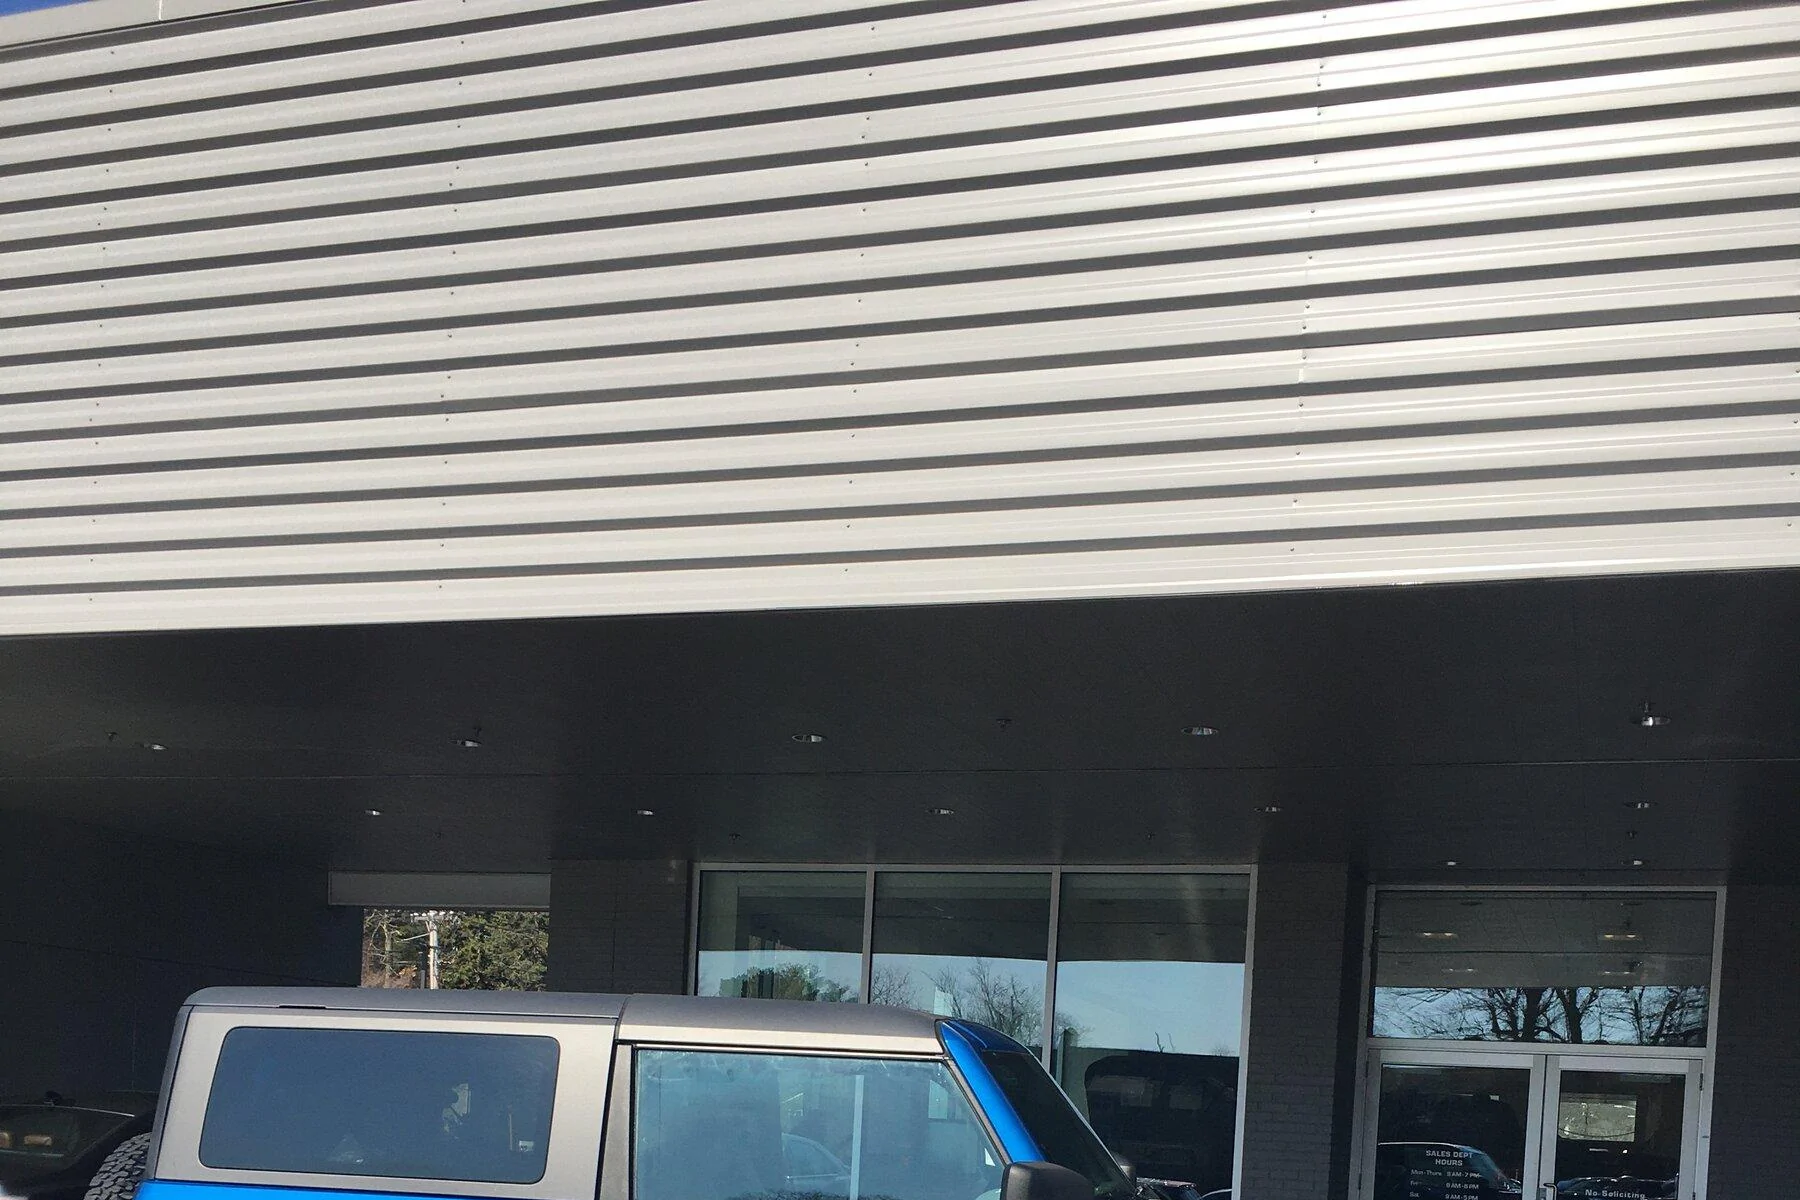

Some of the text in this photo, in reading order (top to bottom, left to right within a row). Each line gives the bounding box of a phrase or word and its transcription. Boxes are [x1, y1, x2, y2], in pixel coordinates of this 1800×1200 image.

[1426, 1150, 1473, 1159] SALES DEPT
[1435, 1159, 1463, 1167] HOURS
[1602, 1190, 1646, 1200] Soliciting
